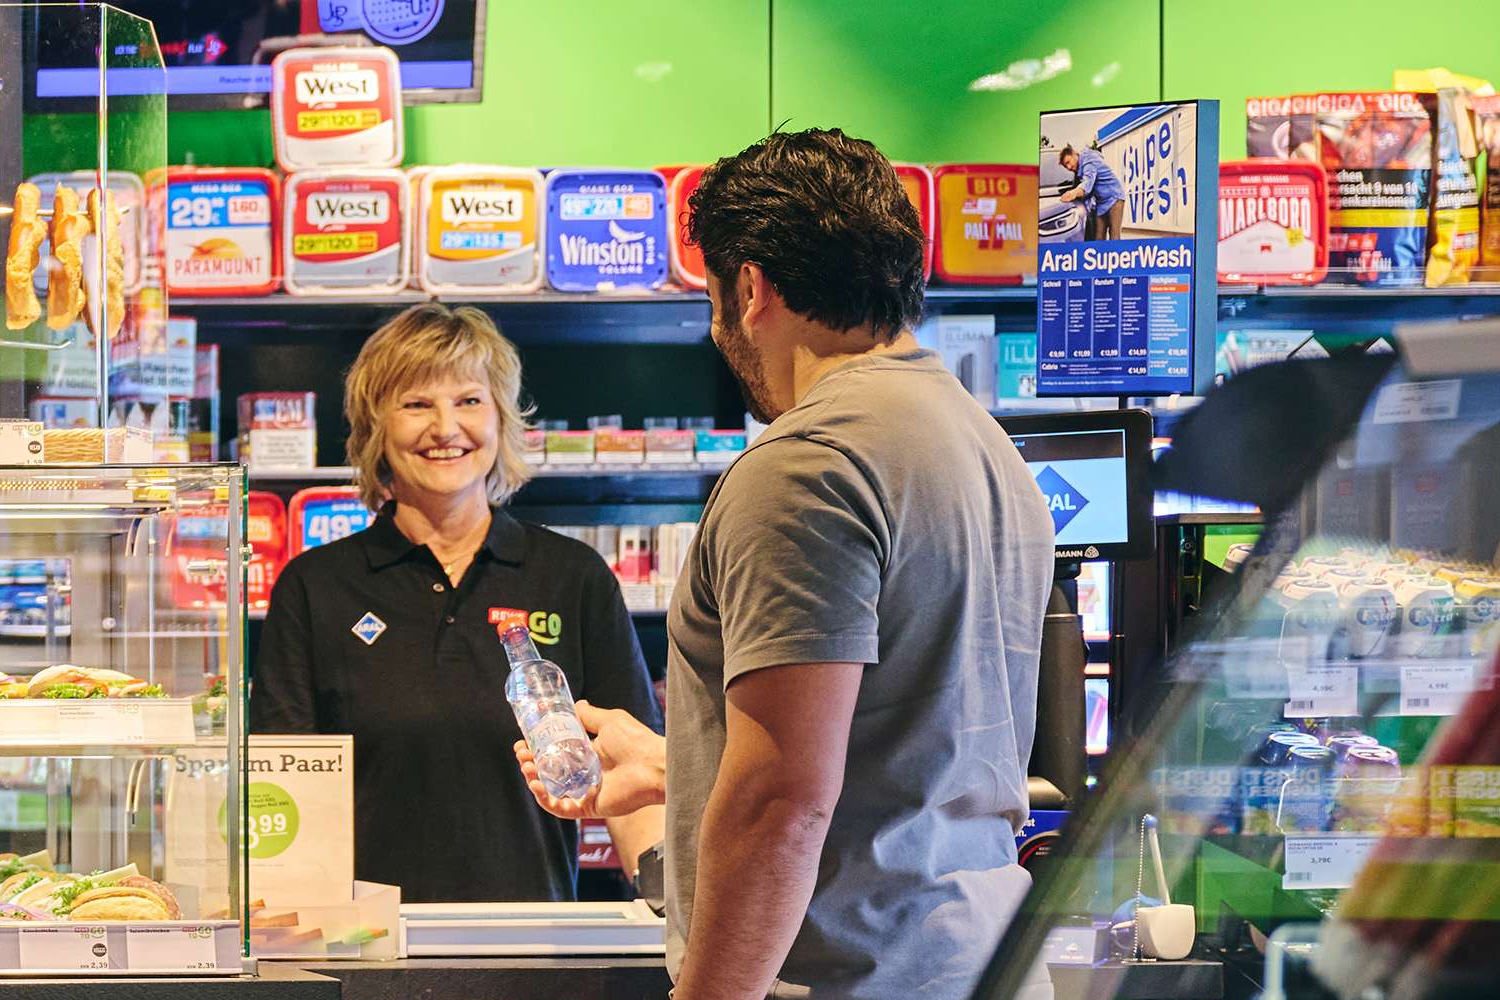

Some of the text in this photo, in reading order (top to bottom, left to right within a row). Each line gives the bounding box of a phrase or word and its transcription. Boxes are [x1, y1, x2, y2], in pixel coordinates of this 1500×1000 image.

[304, 77, 369, 96] West
[974, 177, 1012, 196] BIG
[316, 197, 379, 217] West
[450, 196, 515, 216] West
[1218, 196, 1312, 239] MARLBORO
[964, 221, 1023, 242] PALL MALL
[560, 232, 645, 267] Winston
[1041, 243, 1192, 274] Aral SuperWash
[173, 256, 263, 276] PARAMOUNT
[1045, 493, 1077, 512] RAL
[529, 611, 562, 638] GO
[279, 754, 343, 773] Paar!
[90, 960, 108, 969] 2,39
